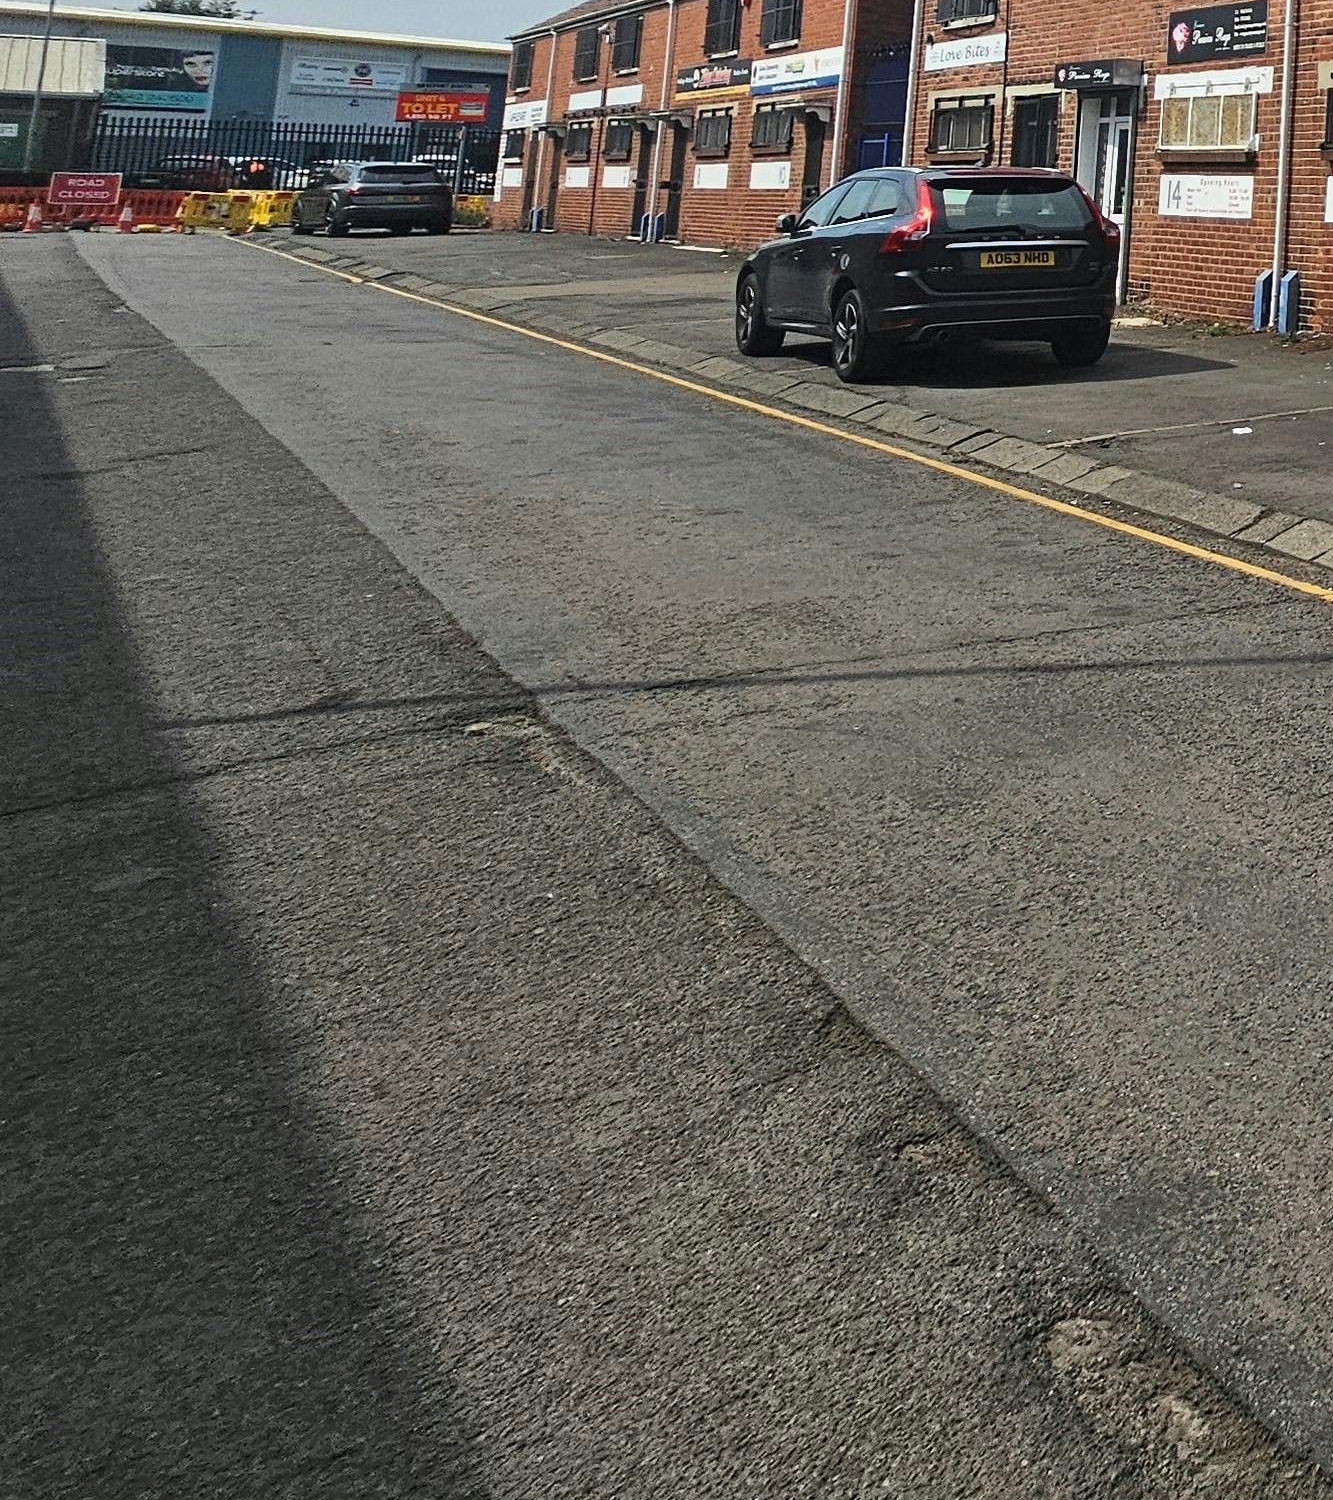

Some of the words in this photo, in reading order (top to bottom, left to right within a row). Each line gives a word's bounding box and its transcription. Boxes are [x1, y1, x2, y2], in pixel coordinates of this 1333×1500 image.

[401, 103, 425, 113] TO
[427, 103, 459, 114] LET
[68, 179, 105, 187] ROAD
[59, 190, 111, 199] CLOSED
[1167, 180, 1182, 209] 14
